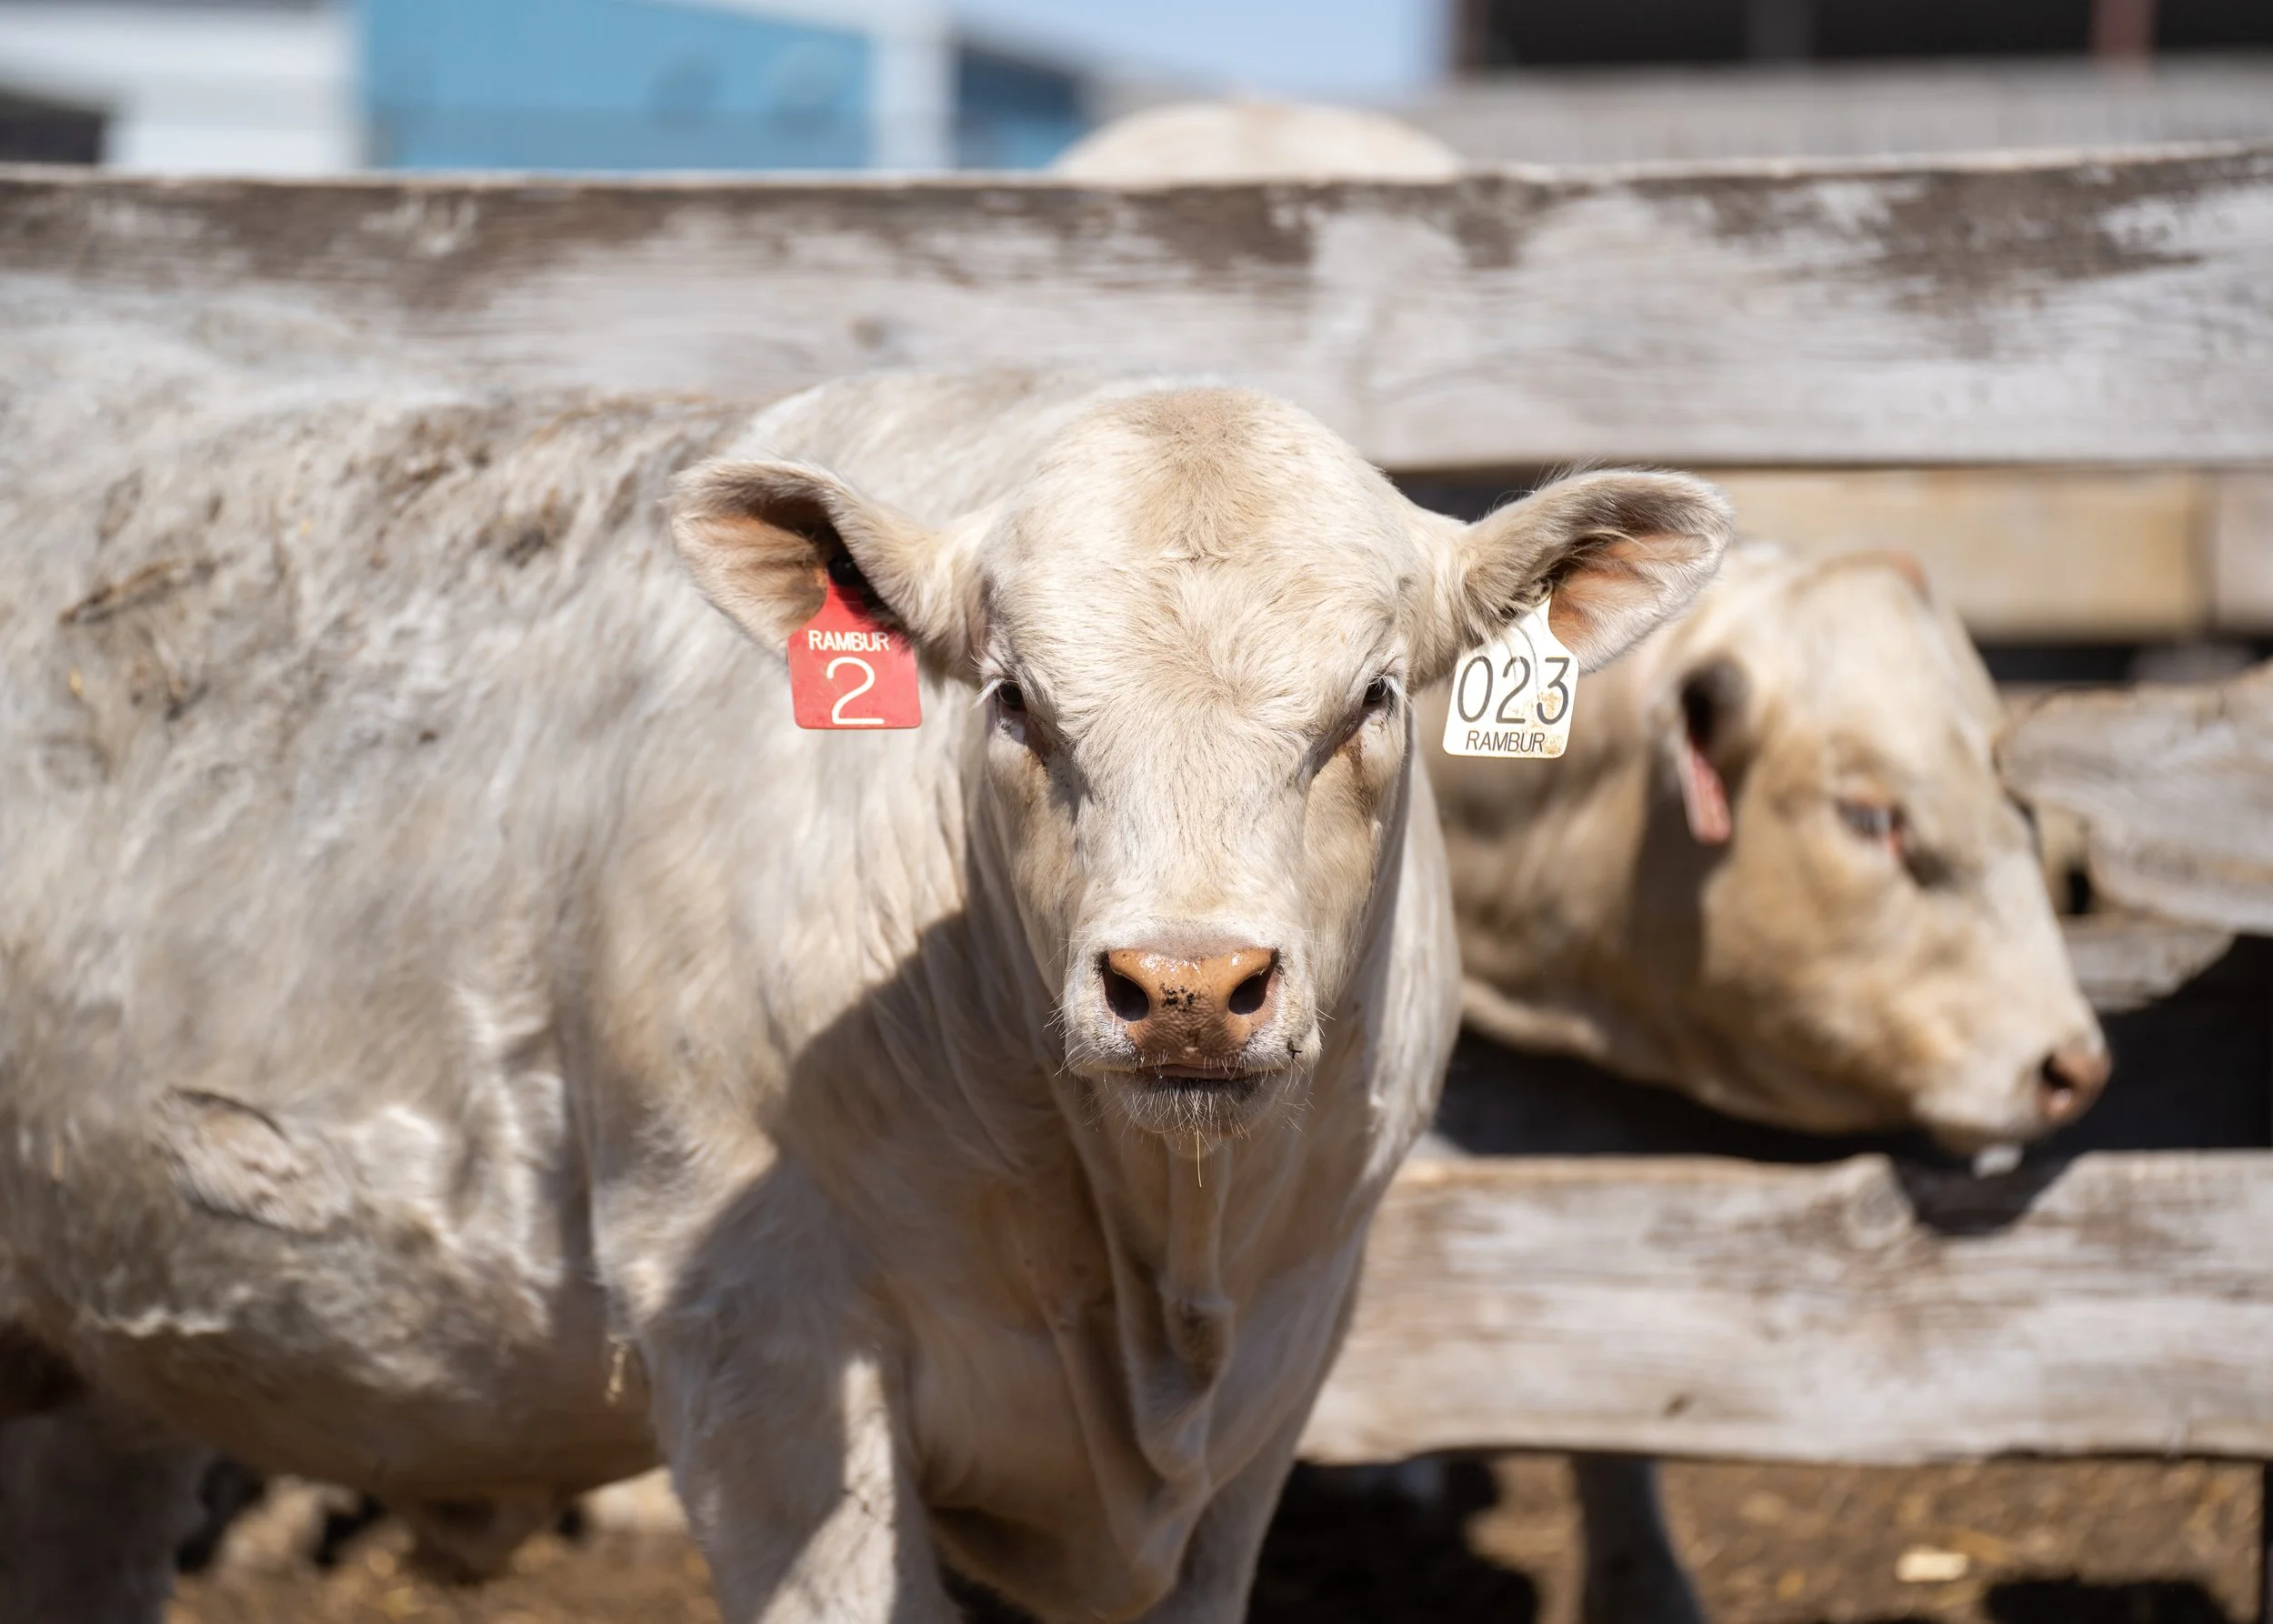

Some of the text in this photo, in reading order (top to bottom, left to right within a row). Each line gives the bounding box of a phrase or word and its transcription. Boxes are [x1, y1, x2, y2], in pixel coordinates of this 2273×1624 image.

[807, 629, 890, 652] RAMBUR
[826, 657, 885, 725] 2
[1457, 656, 1569, 725] 023
[1466, 730, 1546, 753] RAMBUR
